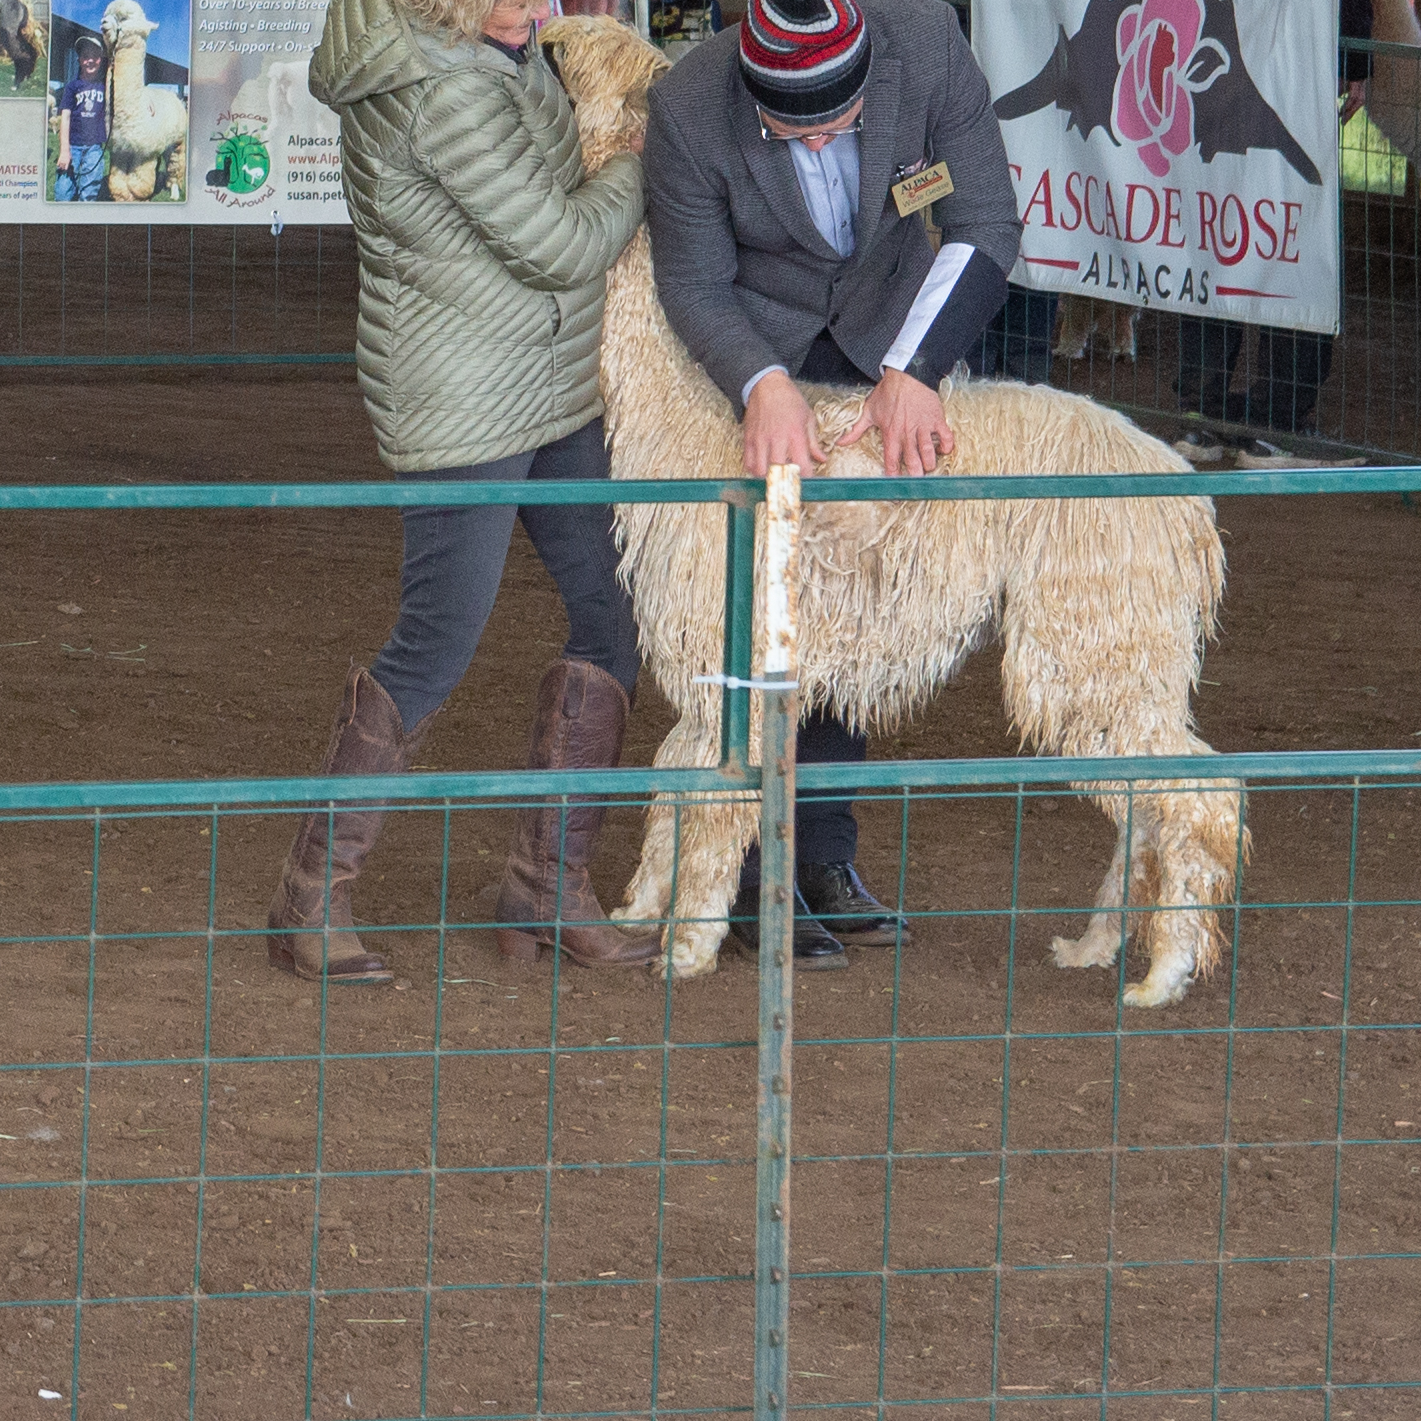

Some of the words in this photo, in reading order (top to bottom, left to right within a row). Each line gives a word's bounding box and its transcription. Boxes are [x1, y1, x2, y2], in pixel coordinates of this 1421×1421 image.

[199, 19, 247, 34] Agisting
[257, 19, 311, 34] Breeding
[198, 41, 227, 53] 24/7
[228, 41, 276, 55] Support
[216, 110, 268, 125] Alpacas
[287, 134, 333, 149] Alpacas
[287, 152, 343, 167] www.Alp
[5, 179, 38, 189] Champion
[287, 171, 316, 183] (916)
[319, 170, 341, 182] 660
[13, 191, 21, 199] of
[204, 188, 228, 205] All
[226, 184, 276, 209] Around
[1009, 163, 1186, 249] ASCADE
[1196, 190, 1303, 267] ROSE
[1081, 251, 1210, 306] ALPACAS
